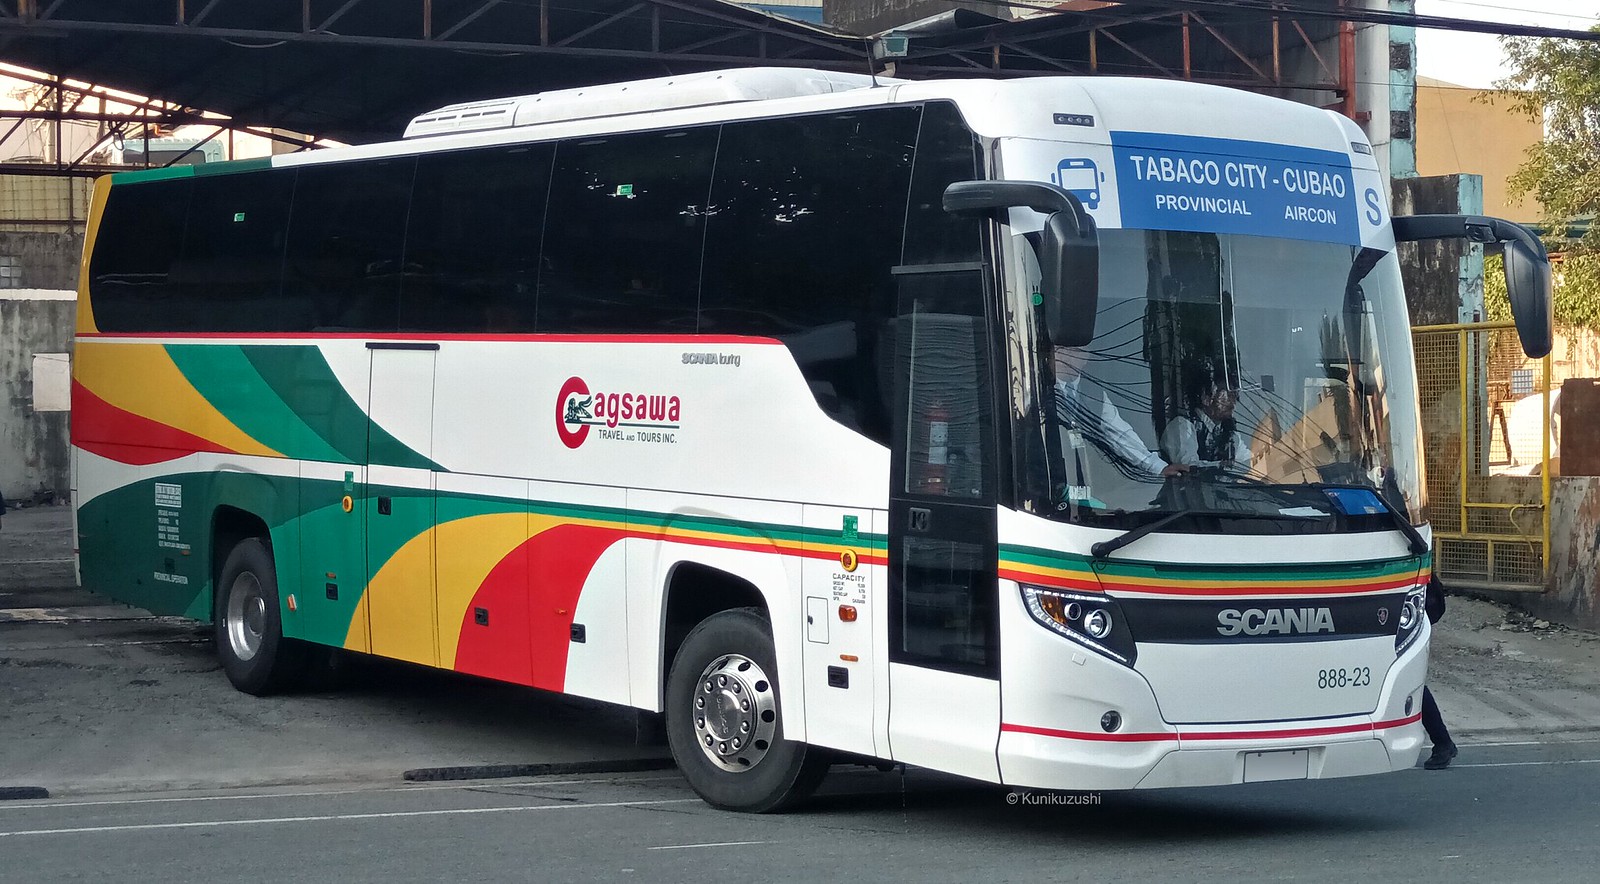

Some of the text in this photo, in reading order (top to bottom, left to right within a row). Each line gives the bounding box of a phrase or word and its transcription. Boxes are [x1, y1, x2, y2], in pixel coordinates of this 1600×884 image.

[1129, 155, 1220, 186] TABACO
[1224, 162, 1269, 190] CITY
[1283, 167, 1346, 199] CUBAO
[1155, 194, 1337, 225] PROVINCIAL AIRCON
[1365, 187, 1382, 226] S
[681, 352, 718, 365] SCANIA
[555, 376, 681, 449] Cagsawa
[598, 429, 625, 441] TRAVEL
[637, 431, 662, 443] TOURS
[662, 433, 677, 444] INC.
[832, 573, 866, 582] CAPACITY
[1216, 607, 1336, 636] SCANIA
[1317, 666, 1371, 690] 888-23
